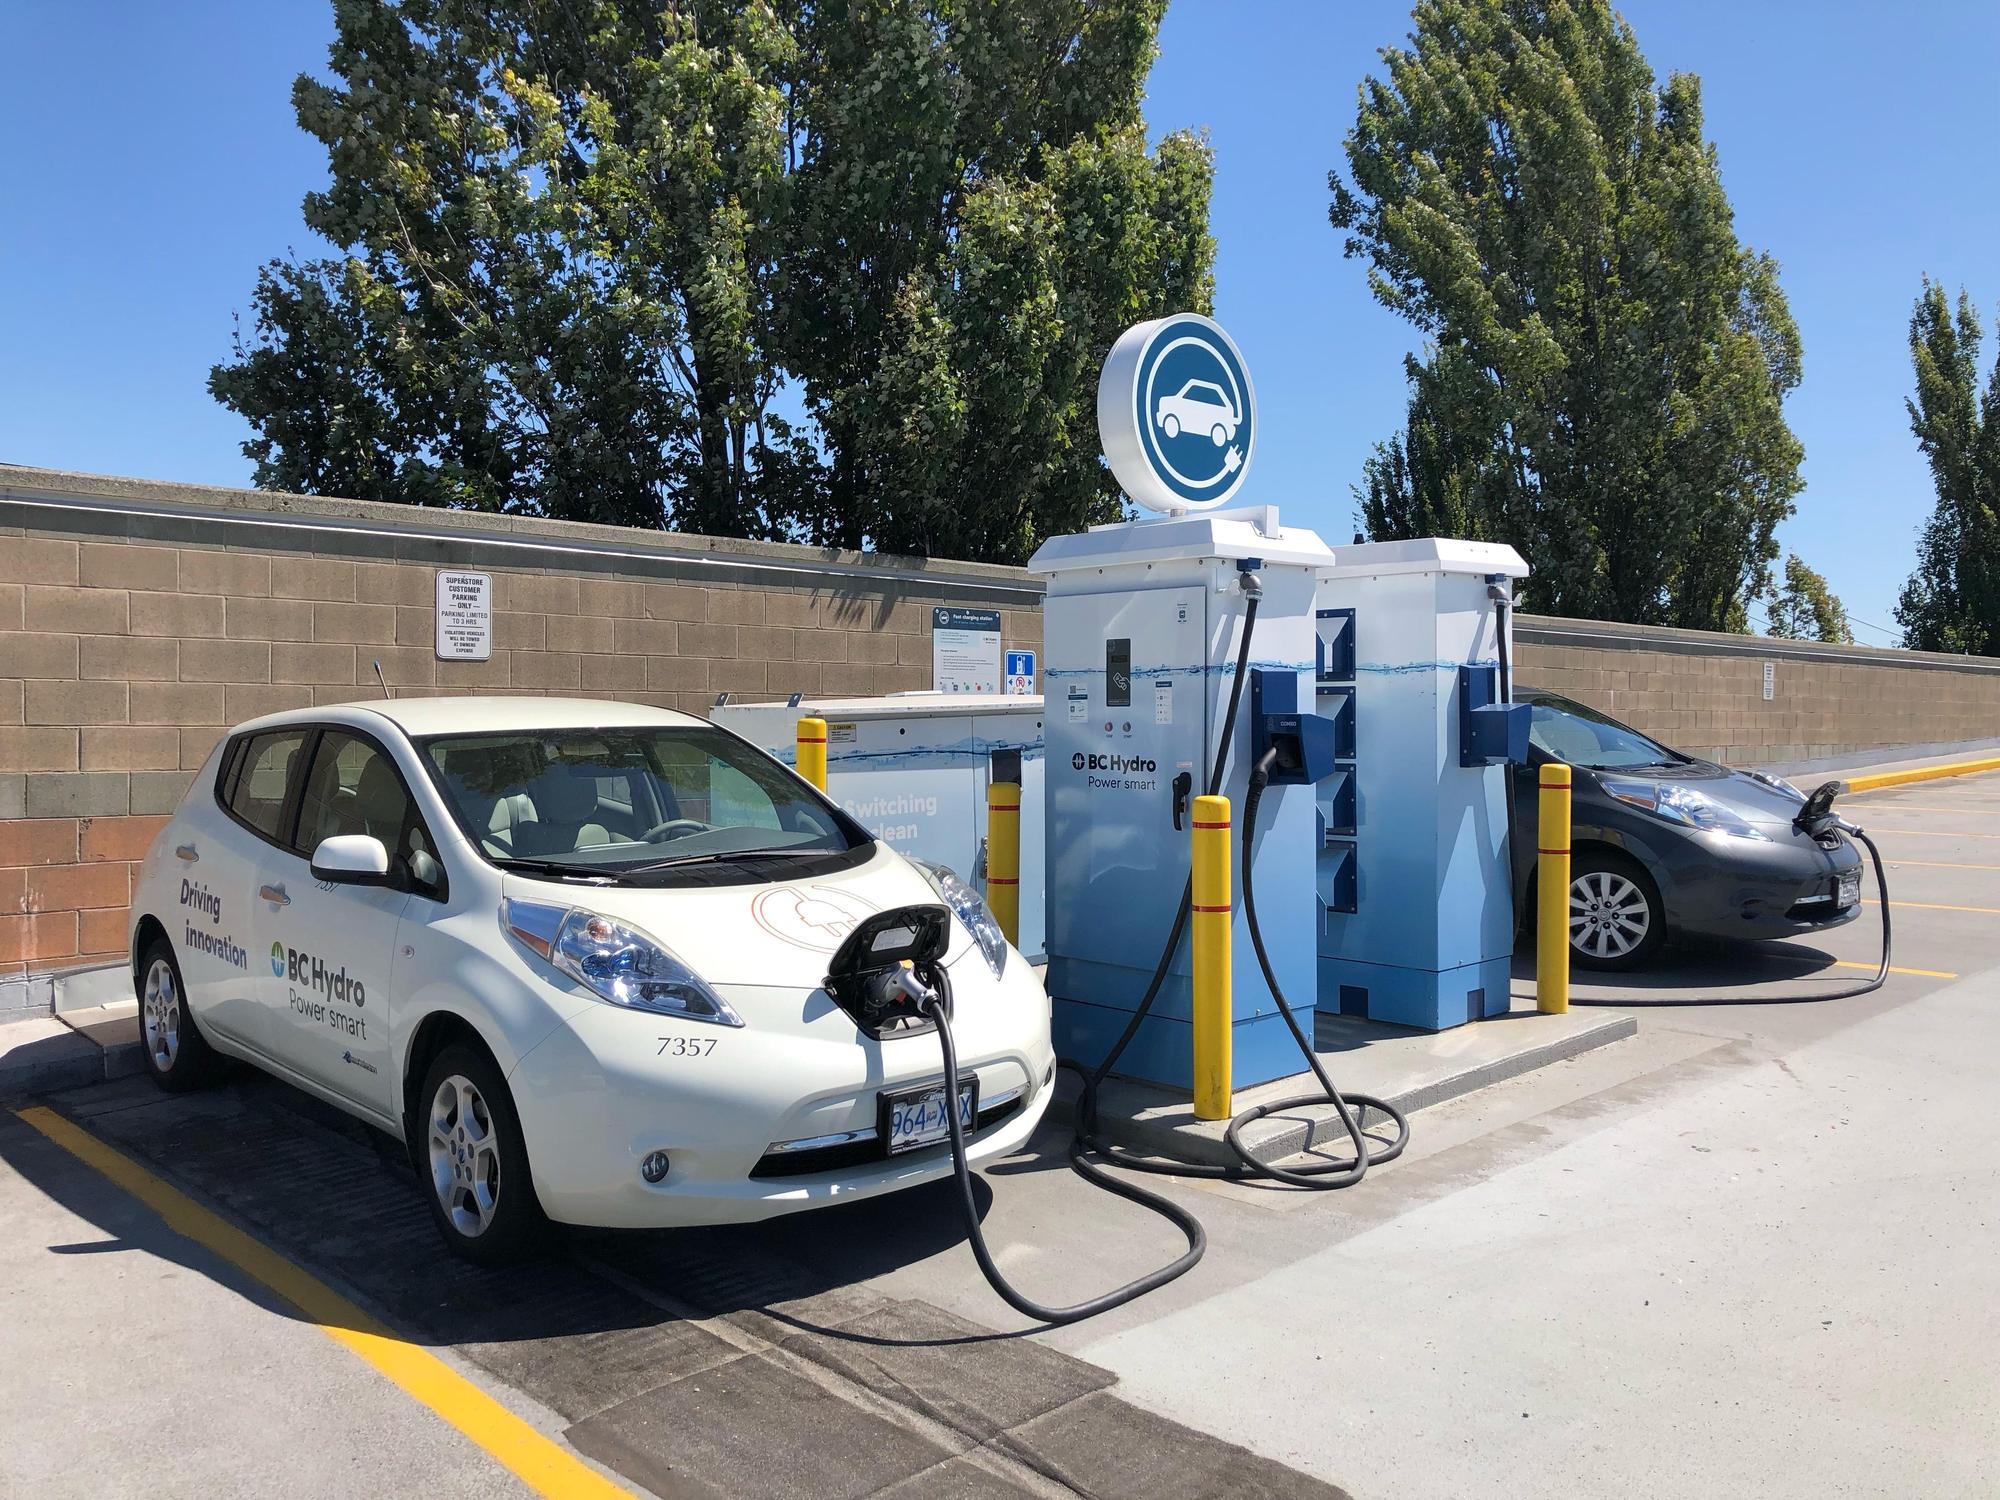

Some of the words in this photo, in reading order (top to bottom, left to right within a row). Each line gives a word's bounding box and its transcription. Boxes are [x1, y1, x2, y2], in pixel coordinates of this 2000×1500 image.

[445, 577, 484, 586] SUPERSTORE
[448, 585, 481, 594] CUSTOMER
[451, 594, 478, 602] PARKING
[441, 610, 466, 618] PARKING
[466, 611, 488, 619] LIMITED
[962, 614, 980, 622] charging
[1088, 753, 1108, 770] BC
[1110, 754, 1157, 775] Hydro
[1088, 775, 1121, 789] Power
[1124, 779, 1156, 791] smart
[843, 793, 937, 817] Switching
[180, 878, 221, 924] Driving
[185, 919, 248, 970] innovation
[287, 948, 309, 986] BC
[312, 956, 366, 1008] Hydro
[289, 987, 326, 1023] Power
[329, 1010, 367, 1041] smart
[656, 1037, 718, 1057] 7357
[892, 1103, 926, 1139] 964
[937, 1095, 971, 1127] XX
